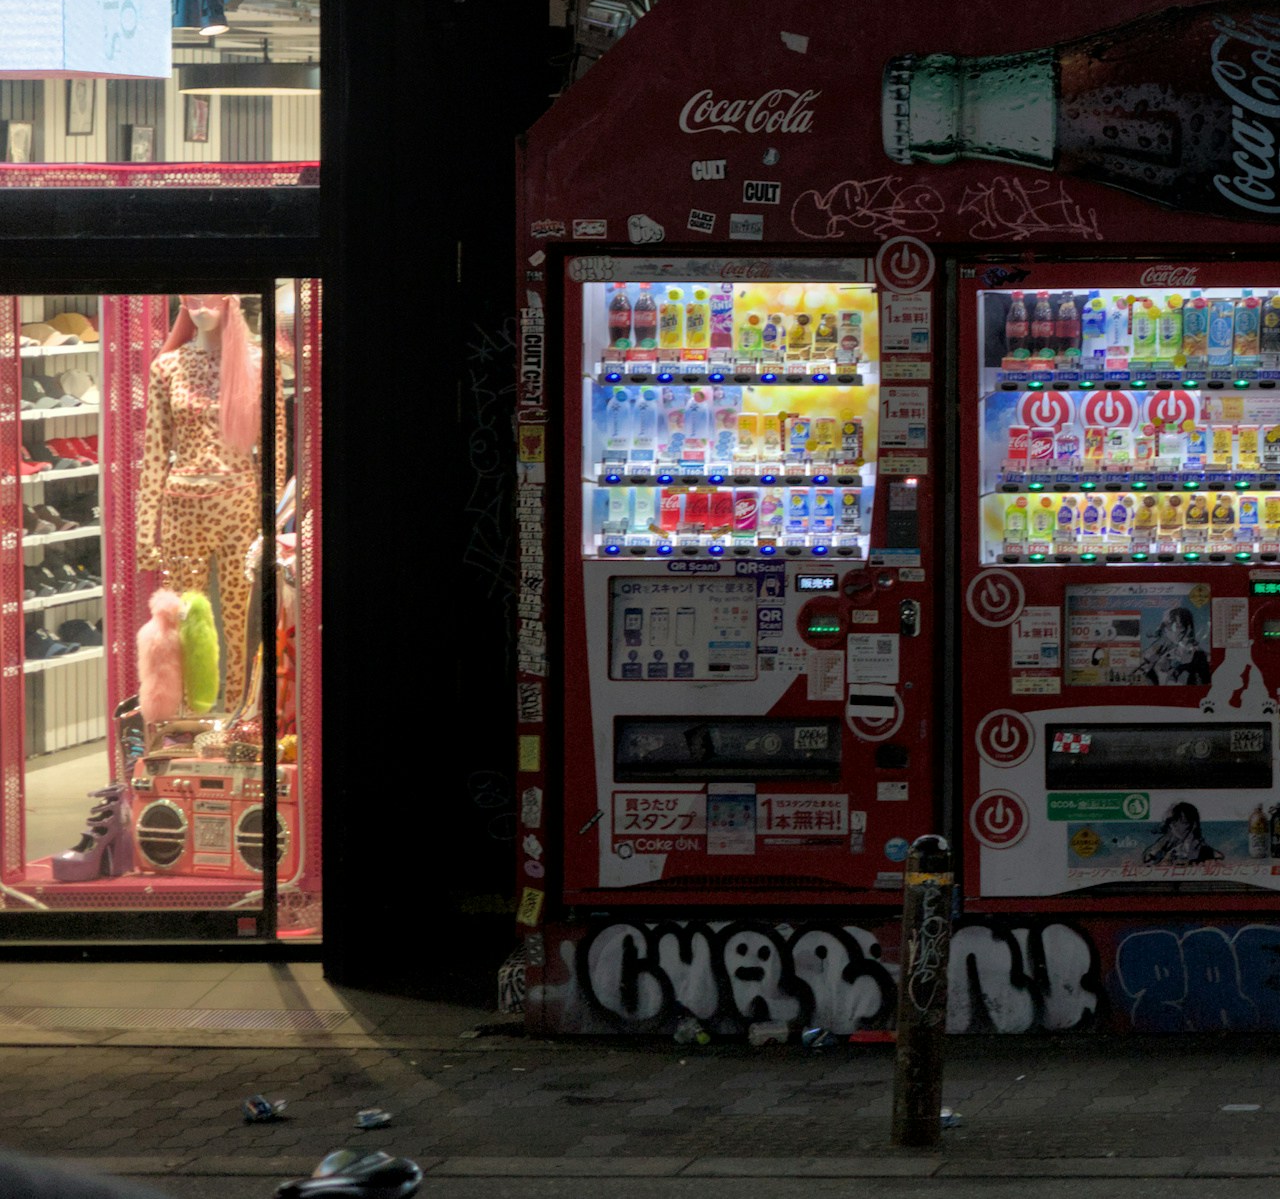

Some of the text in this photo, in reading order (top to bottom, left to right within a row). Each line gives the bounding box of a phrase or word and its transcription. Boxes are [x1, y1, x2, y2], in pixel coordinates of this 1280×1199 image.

[679, 88, 823, 135] Coca-Cola
[691, 159, 728, 182] CULT
[745, 182, 780, 203] CULT
[1140, 266, 1200, 287] Coca-Cola
[524, 334, 541, 368] CULT
[669, 561, 718, 571] QR Scan!
[736, 562, 784, 573] QR Scan!
[800, 577, 834, 589] 販売中
[759, 609, 781, 621] QR
[624, 798, 678, 811] 買うたび
[624, 811, 697, 831] スタンプ
[636, 838, 673, 851] Coke
